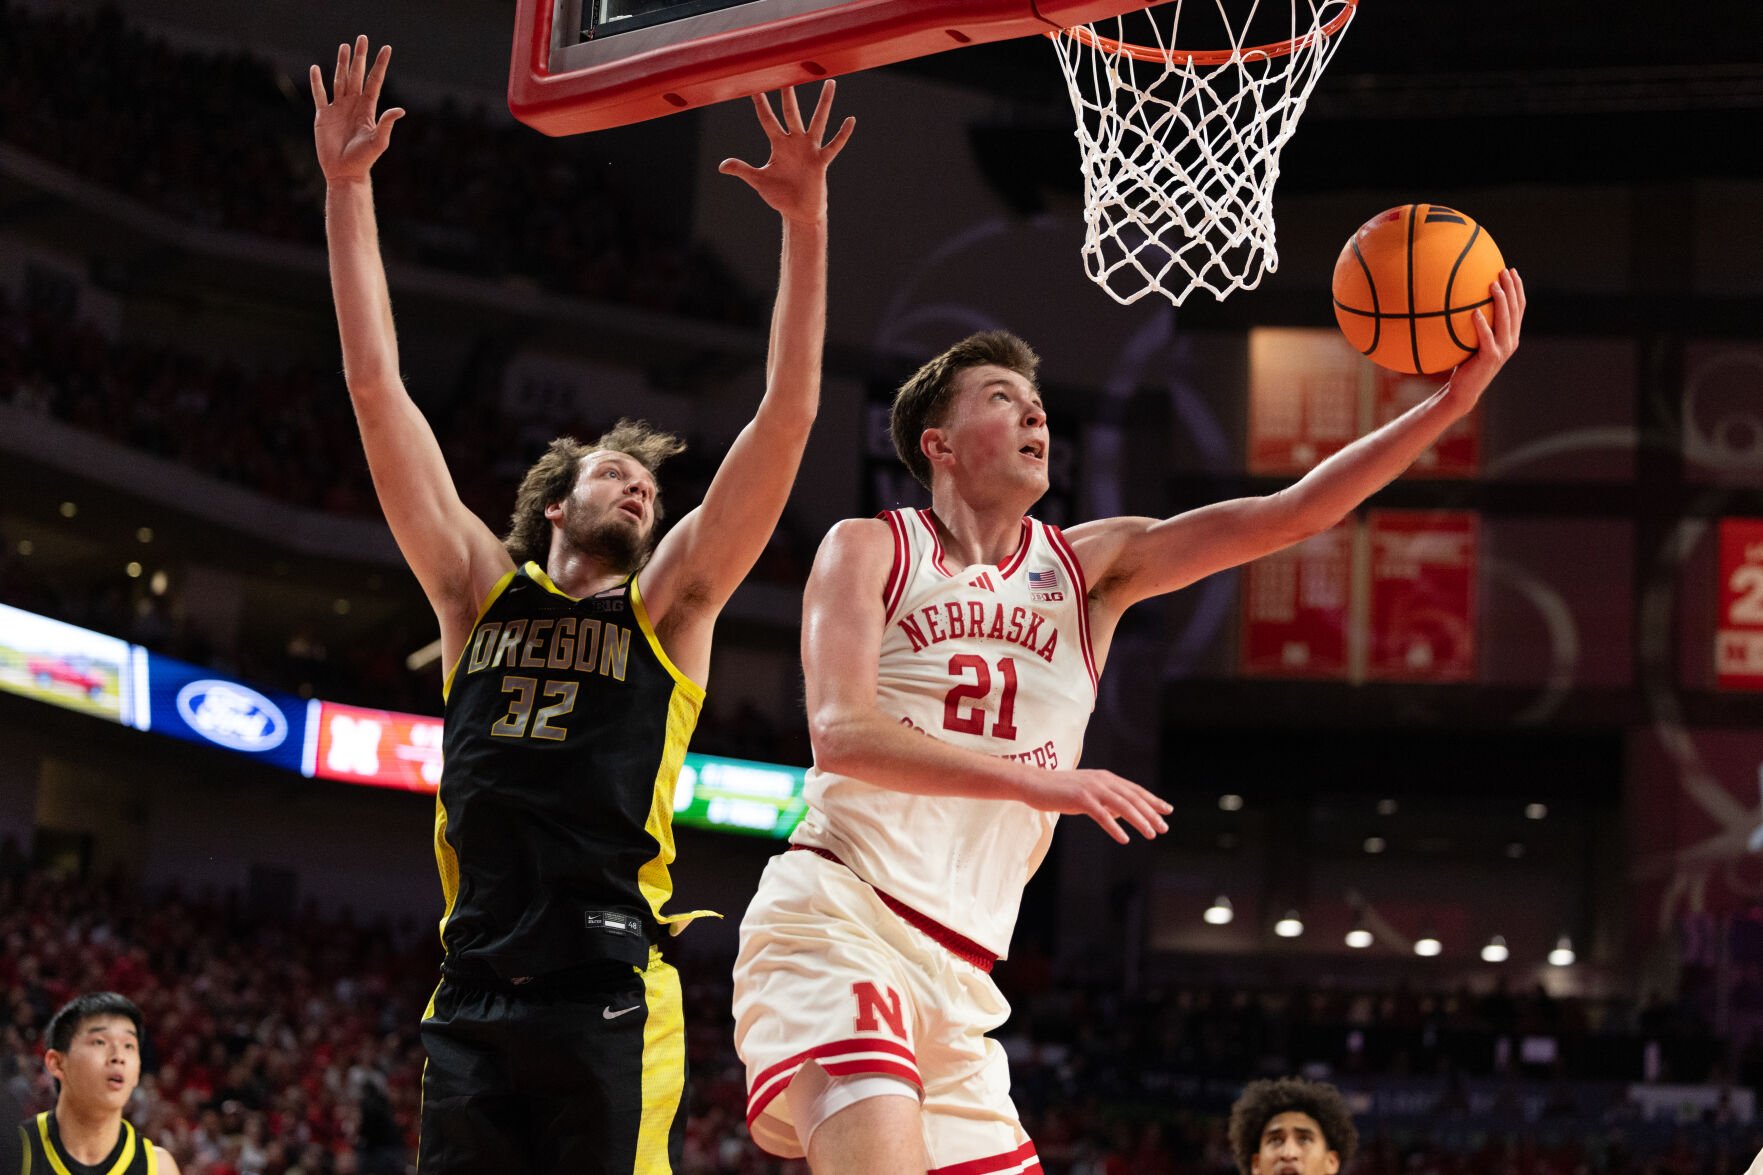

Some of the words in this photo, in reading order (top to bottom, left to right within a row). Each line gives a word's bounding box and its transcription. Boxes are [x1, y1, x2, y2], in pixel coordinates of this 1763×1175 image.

[467, 617, 632, 682] OREGON
[897, 601, 1059, 664] NEBRASKA
[490, 675, 580, 742] 32
[942, 653, 1018, 741] 21
[628, 921, 637, 930] 48
[850, 981, 908, 1041] N
